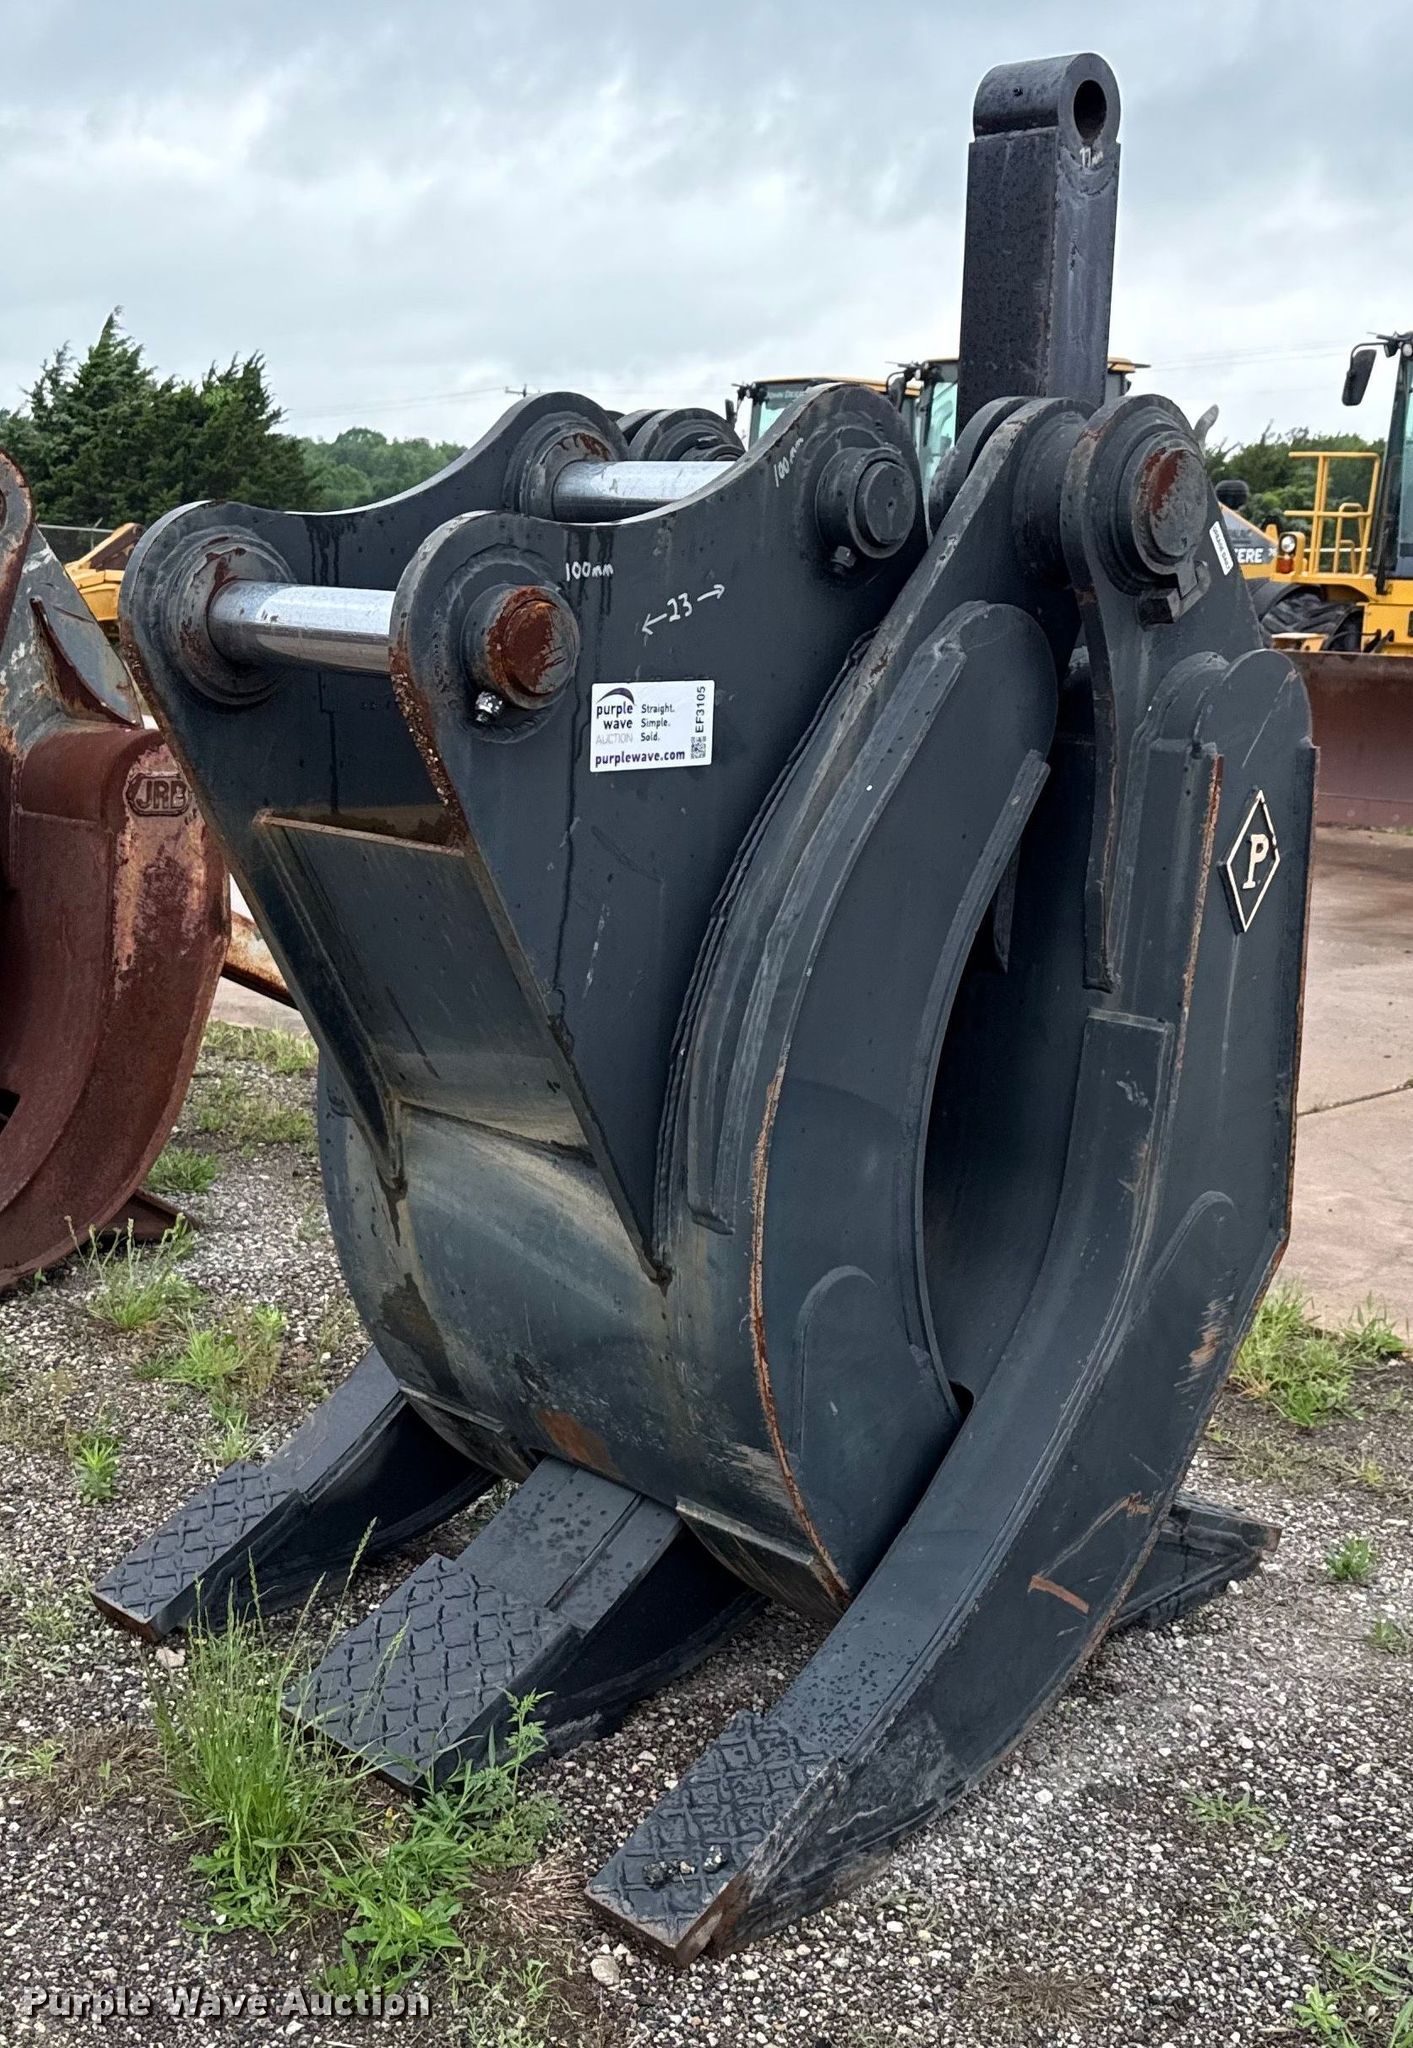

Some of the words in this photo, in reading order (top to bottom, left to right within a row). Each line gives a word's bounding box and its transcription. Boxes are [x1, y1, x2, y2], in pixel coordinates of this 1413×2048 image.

[565, 560, 615, 582] 100mm
[667, 592, 693, 622] 23
[596, 701, 634, 719] purple
[641, 703, 675, 716] Straight.
[695, 686, 706, 733] EF3105
[603, 719, 633, 730] wave
[641, 718, 671, 729] Simple.
[595, 733, 633, 745] AUCTION
[640, 732, 661, 742] Sold.
[595, 750, 686, 768] purplewave.com
[1242, 834, 1270, 890] P
